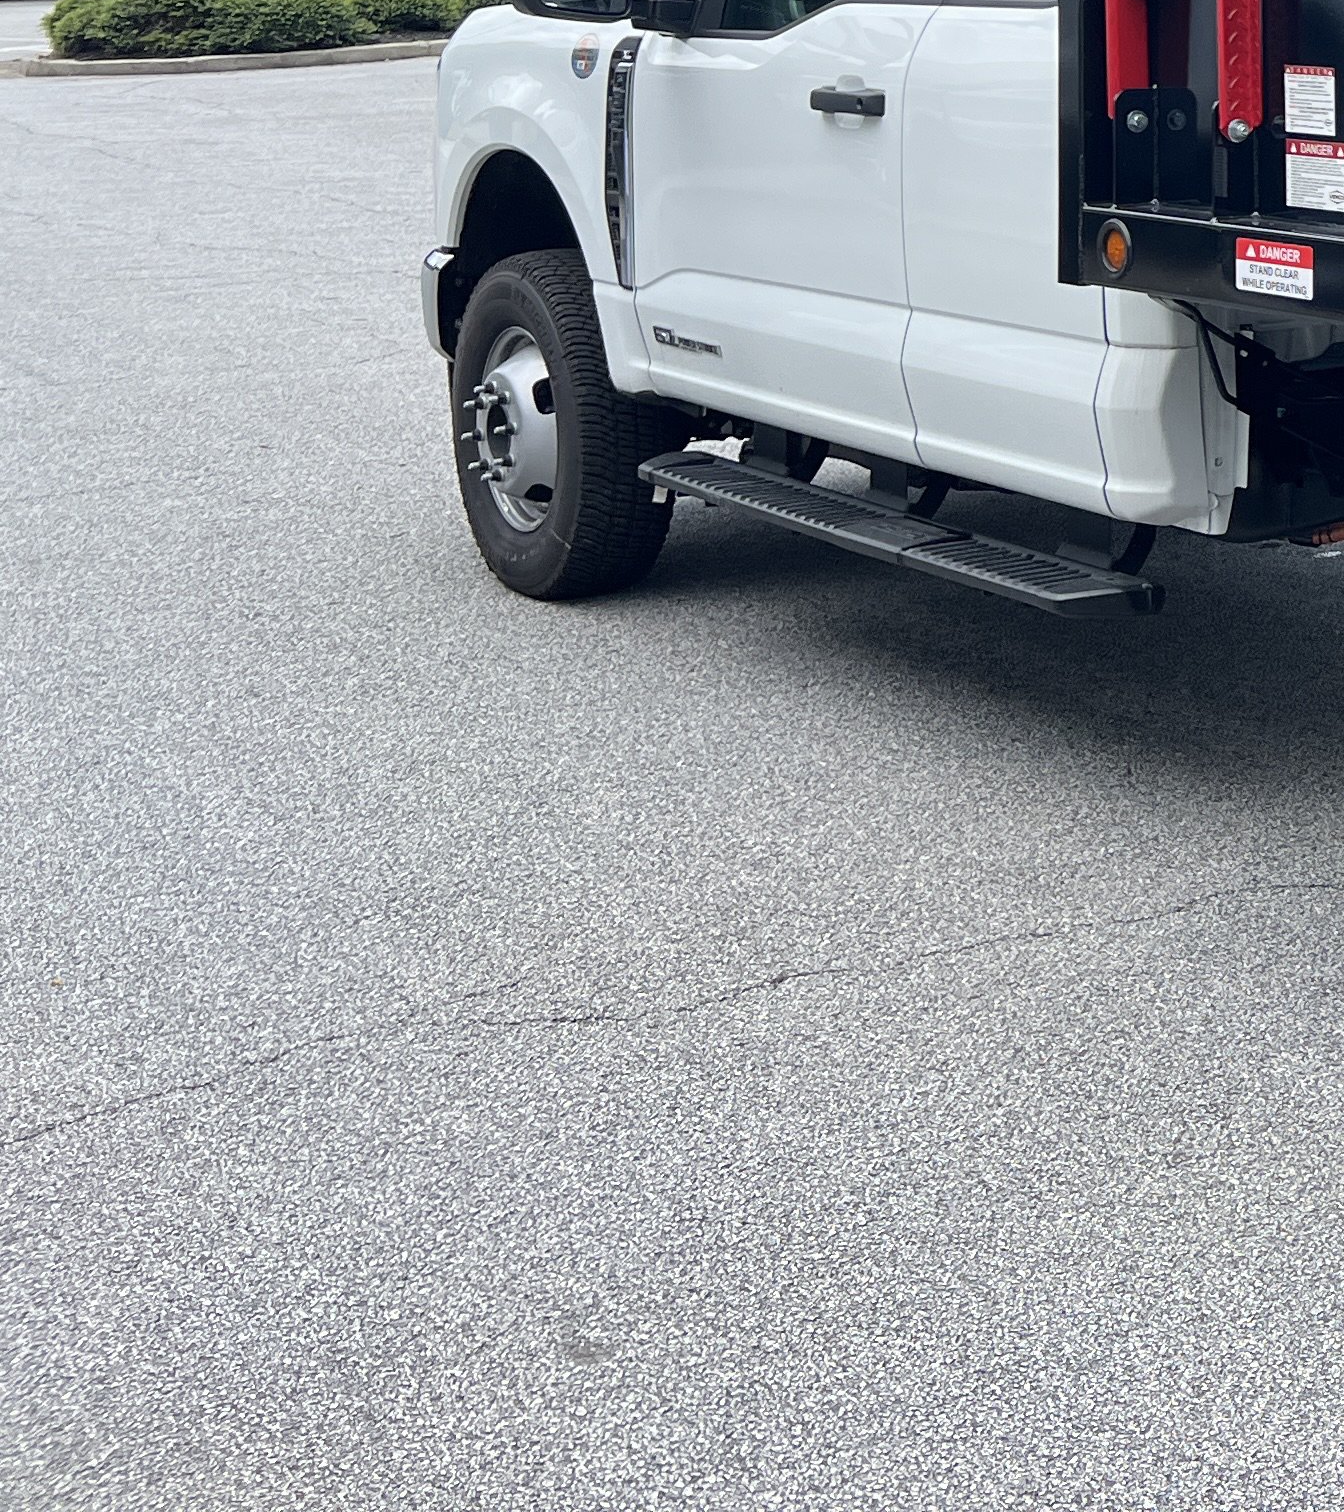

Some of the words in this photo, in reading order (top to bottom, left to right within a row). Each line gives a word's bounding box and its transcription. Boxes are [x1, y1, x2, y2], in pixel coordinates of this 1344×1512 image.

[1300, 142, 1333, 156] DANGER
[1259, 245, 1300, 263] DANGER
[1249, 264, 1273, 276] STAND
[1274, 268, 1299, 280] CLEAR
[1242, 277, 1264, 290] WHILE
[1265, 280, 1308, 296] OPERATING
